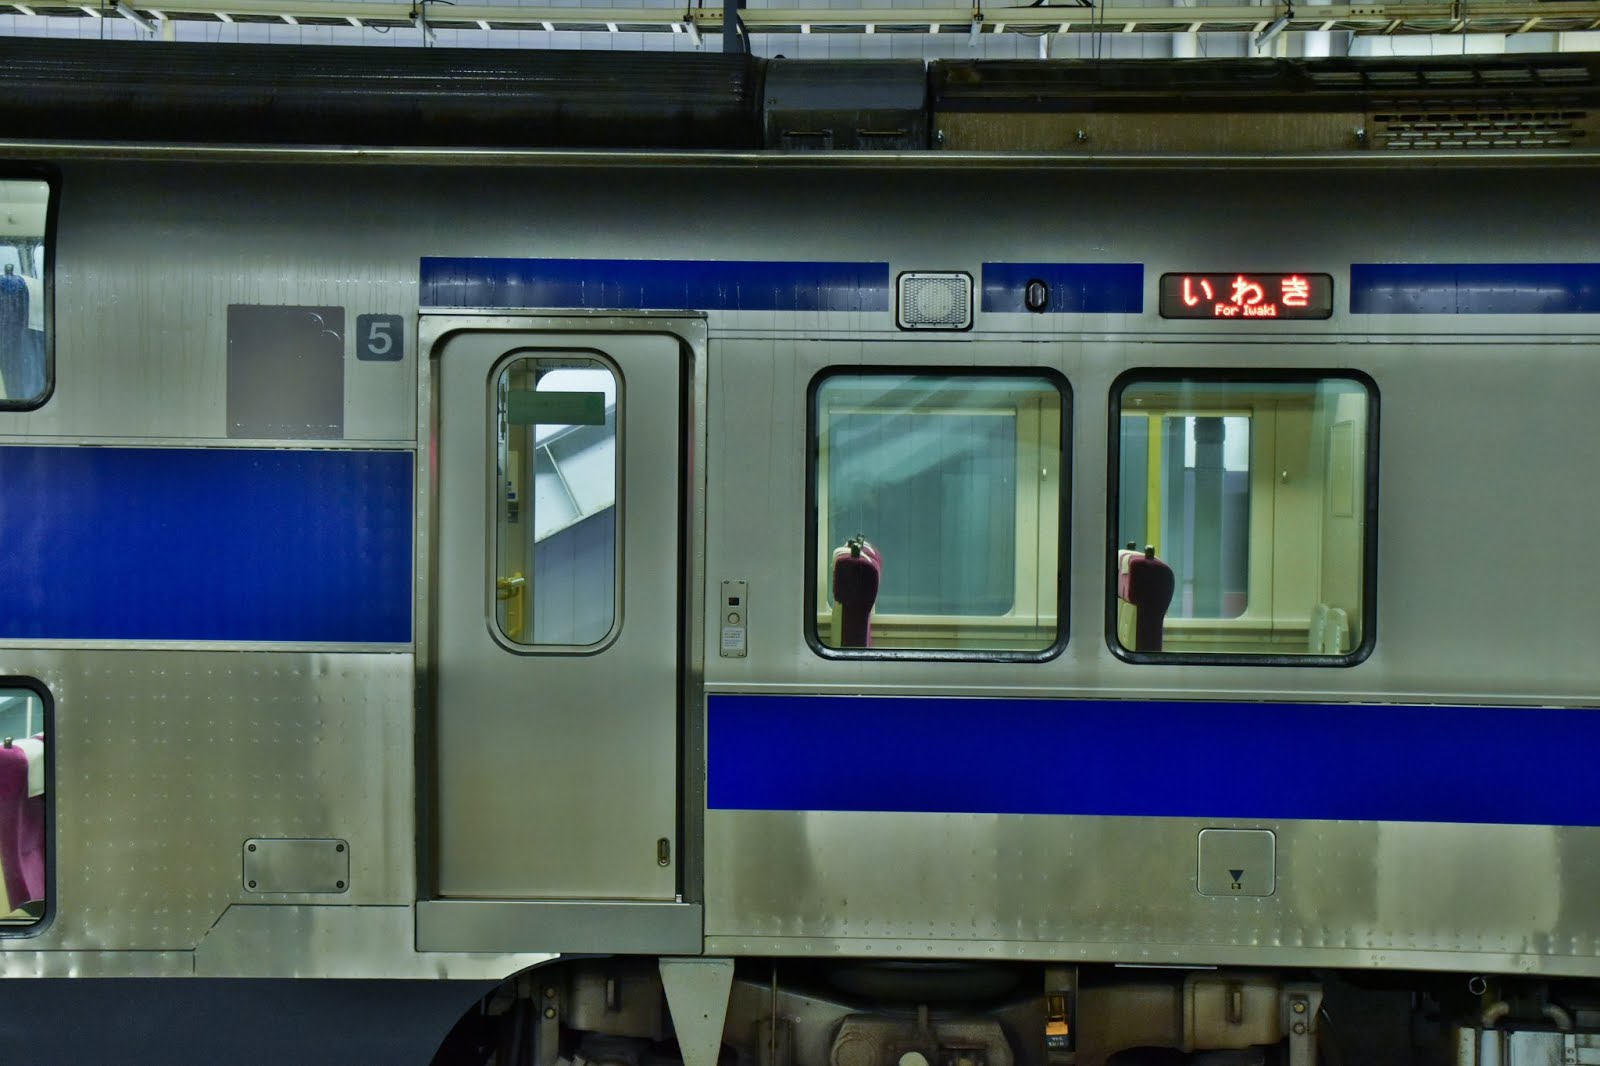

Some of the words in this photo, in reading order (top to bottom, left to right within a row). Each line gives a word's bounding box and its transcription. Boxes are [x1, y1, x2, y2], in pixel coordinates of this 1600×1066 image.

[1183, 275, 1309, 306] いわき
[1214, 304, 1239, 317] For
[1242, 304, 1277, 317] Iwaki
[368, 322, 392, 354] 5
